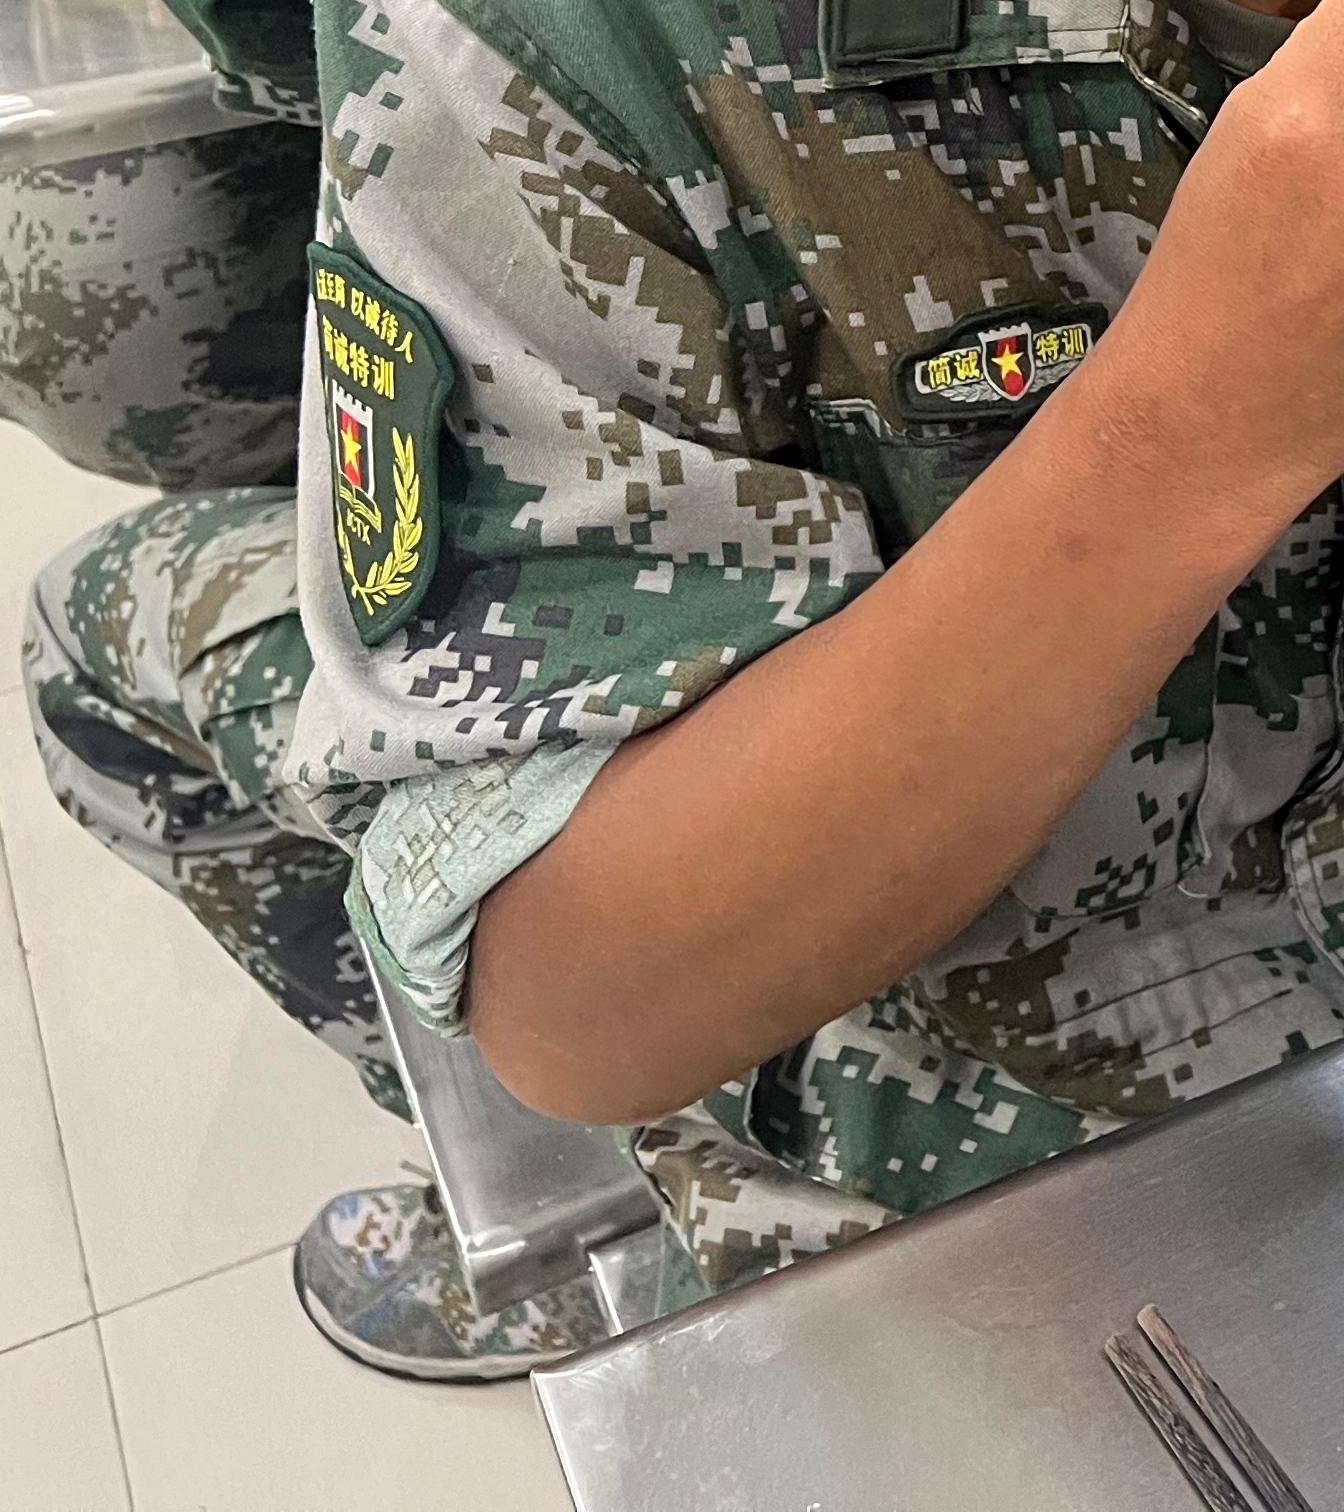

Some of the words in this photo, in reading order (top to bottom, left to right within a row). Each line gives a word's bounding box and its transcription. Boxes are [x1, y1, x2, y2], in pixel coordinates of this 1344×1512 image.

[351, 287, 413, 363] 以诚待人
[928, 350, 981, 389] 简诚
[1035, 327, 1085, 363] 特训
